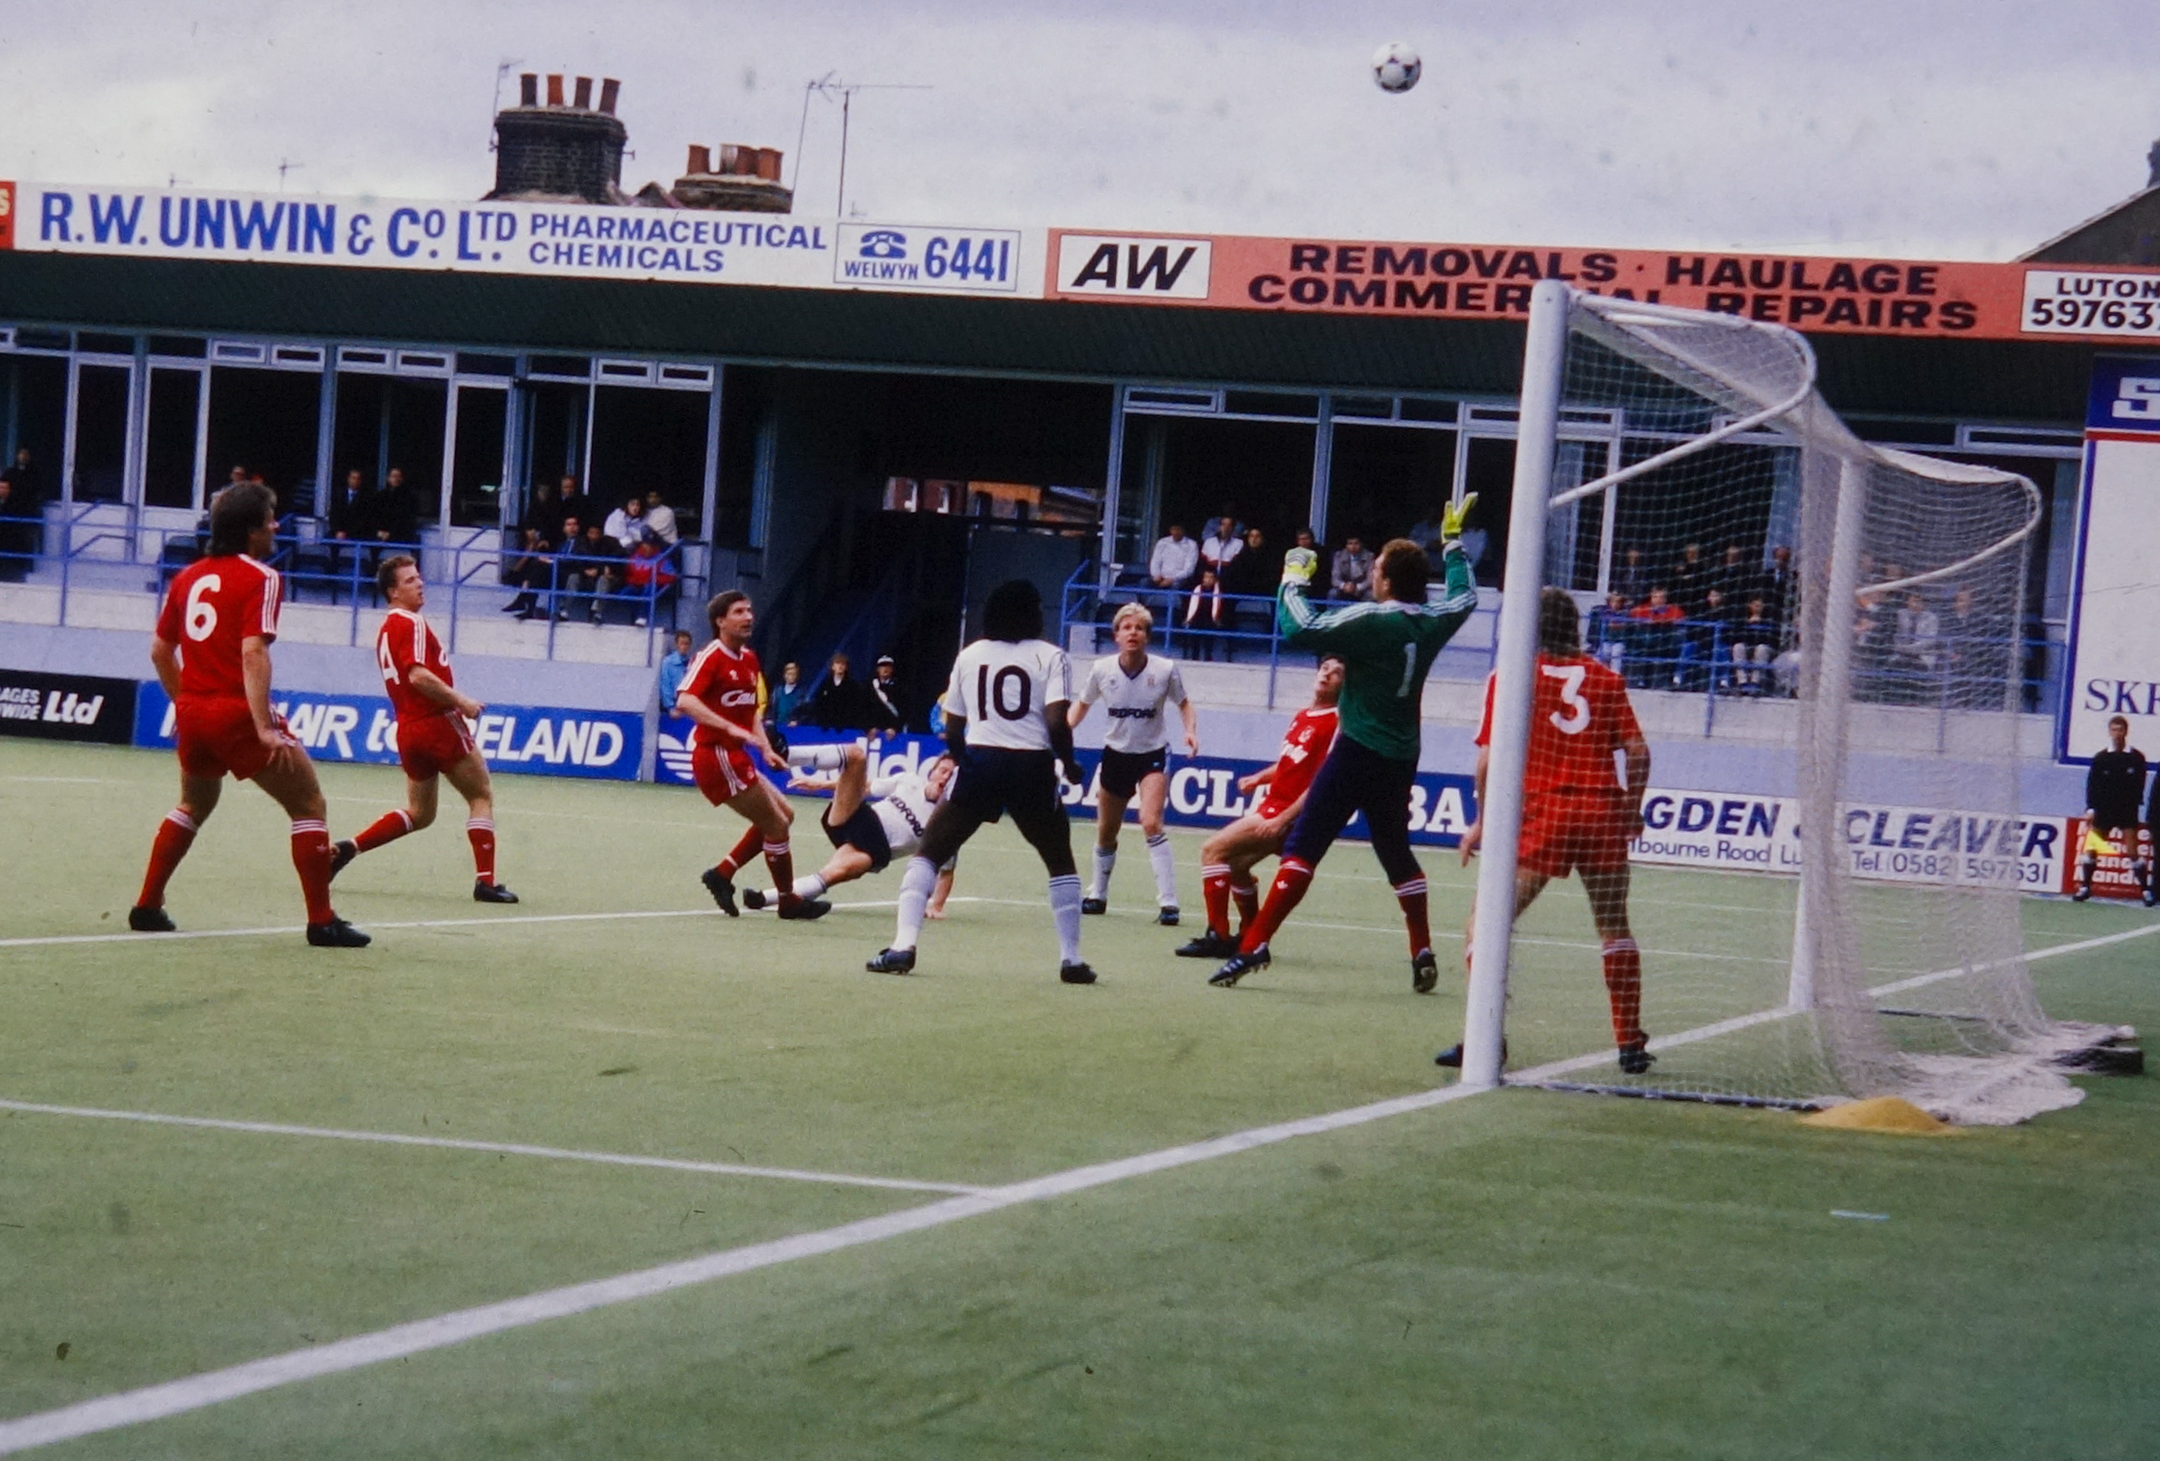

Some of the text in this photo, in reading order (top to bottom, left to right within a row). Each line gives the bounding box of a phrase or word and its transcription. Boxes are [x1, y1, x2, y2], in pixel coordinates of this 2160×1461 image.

[160, 196, 337, 254] UNWIN
[347, 213, 375, 255] &
[530, 212, 827, 250] PHARMACEUTICAL
[529, 242, 724, 272] CHEMICALS
[844, 260, 919, 281] WELWYN
[924, 236, 1009, 282] 6441
[1072, 243, 1198, 290] AW
[1289, 243, 1939, 296] REMOVALS HAULAGE
[1247, 274, 1978, 331] COMMER REPAIRS
[2057, 277, 2160, 298] LUTON
[2030, 298, 2160, 329] 59763
[185, 573, 222, 642] 6
[977, 664, 1032, 722] 10
[1397, 642, 1417, 698] 1
[42, 690, 104, 725] Ltd
[1541, 664, 1591, 735] 3
[462, 714, 624, 767] ELAND
[1846, 809, 2059, 859] CLEAVER
[1716, 840, 1771, 863] Road
[1965, 858, 2050, 884] 597631
